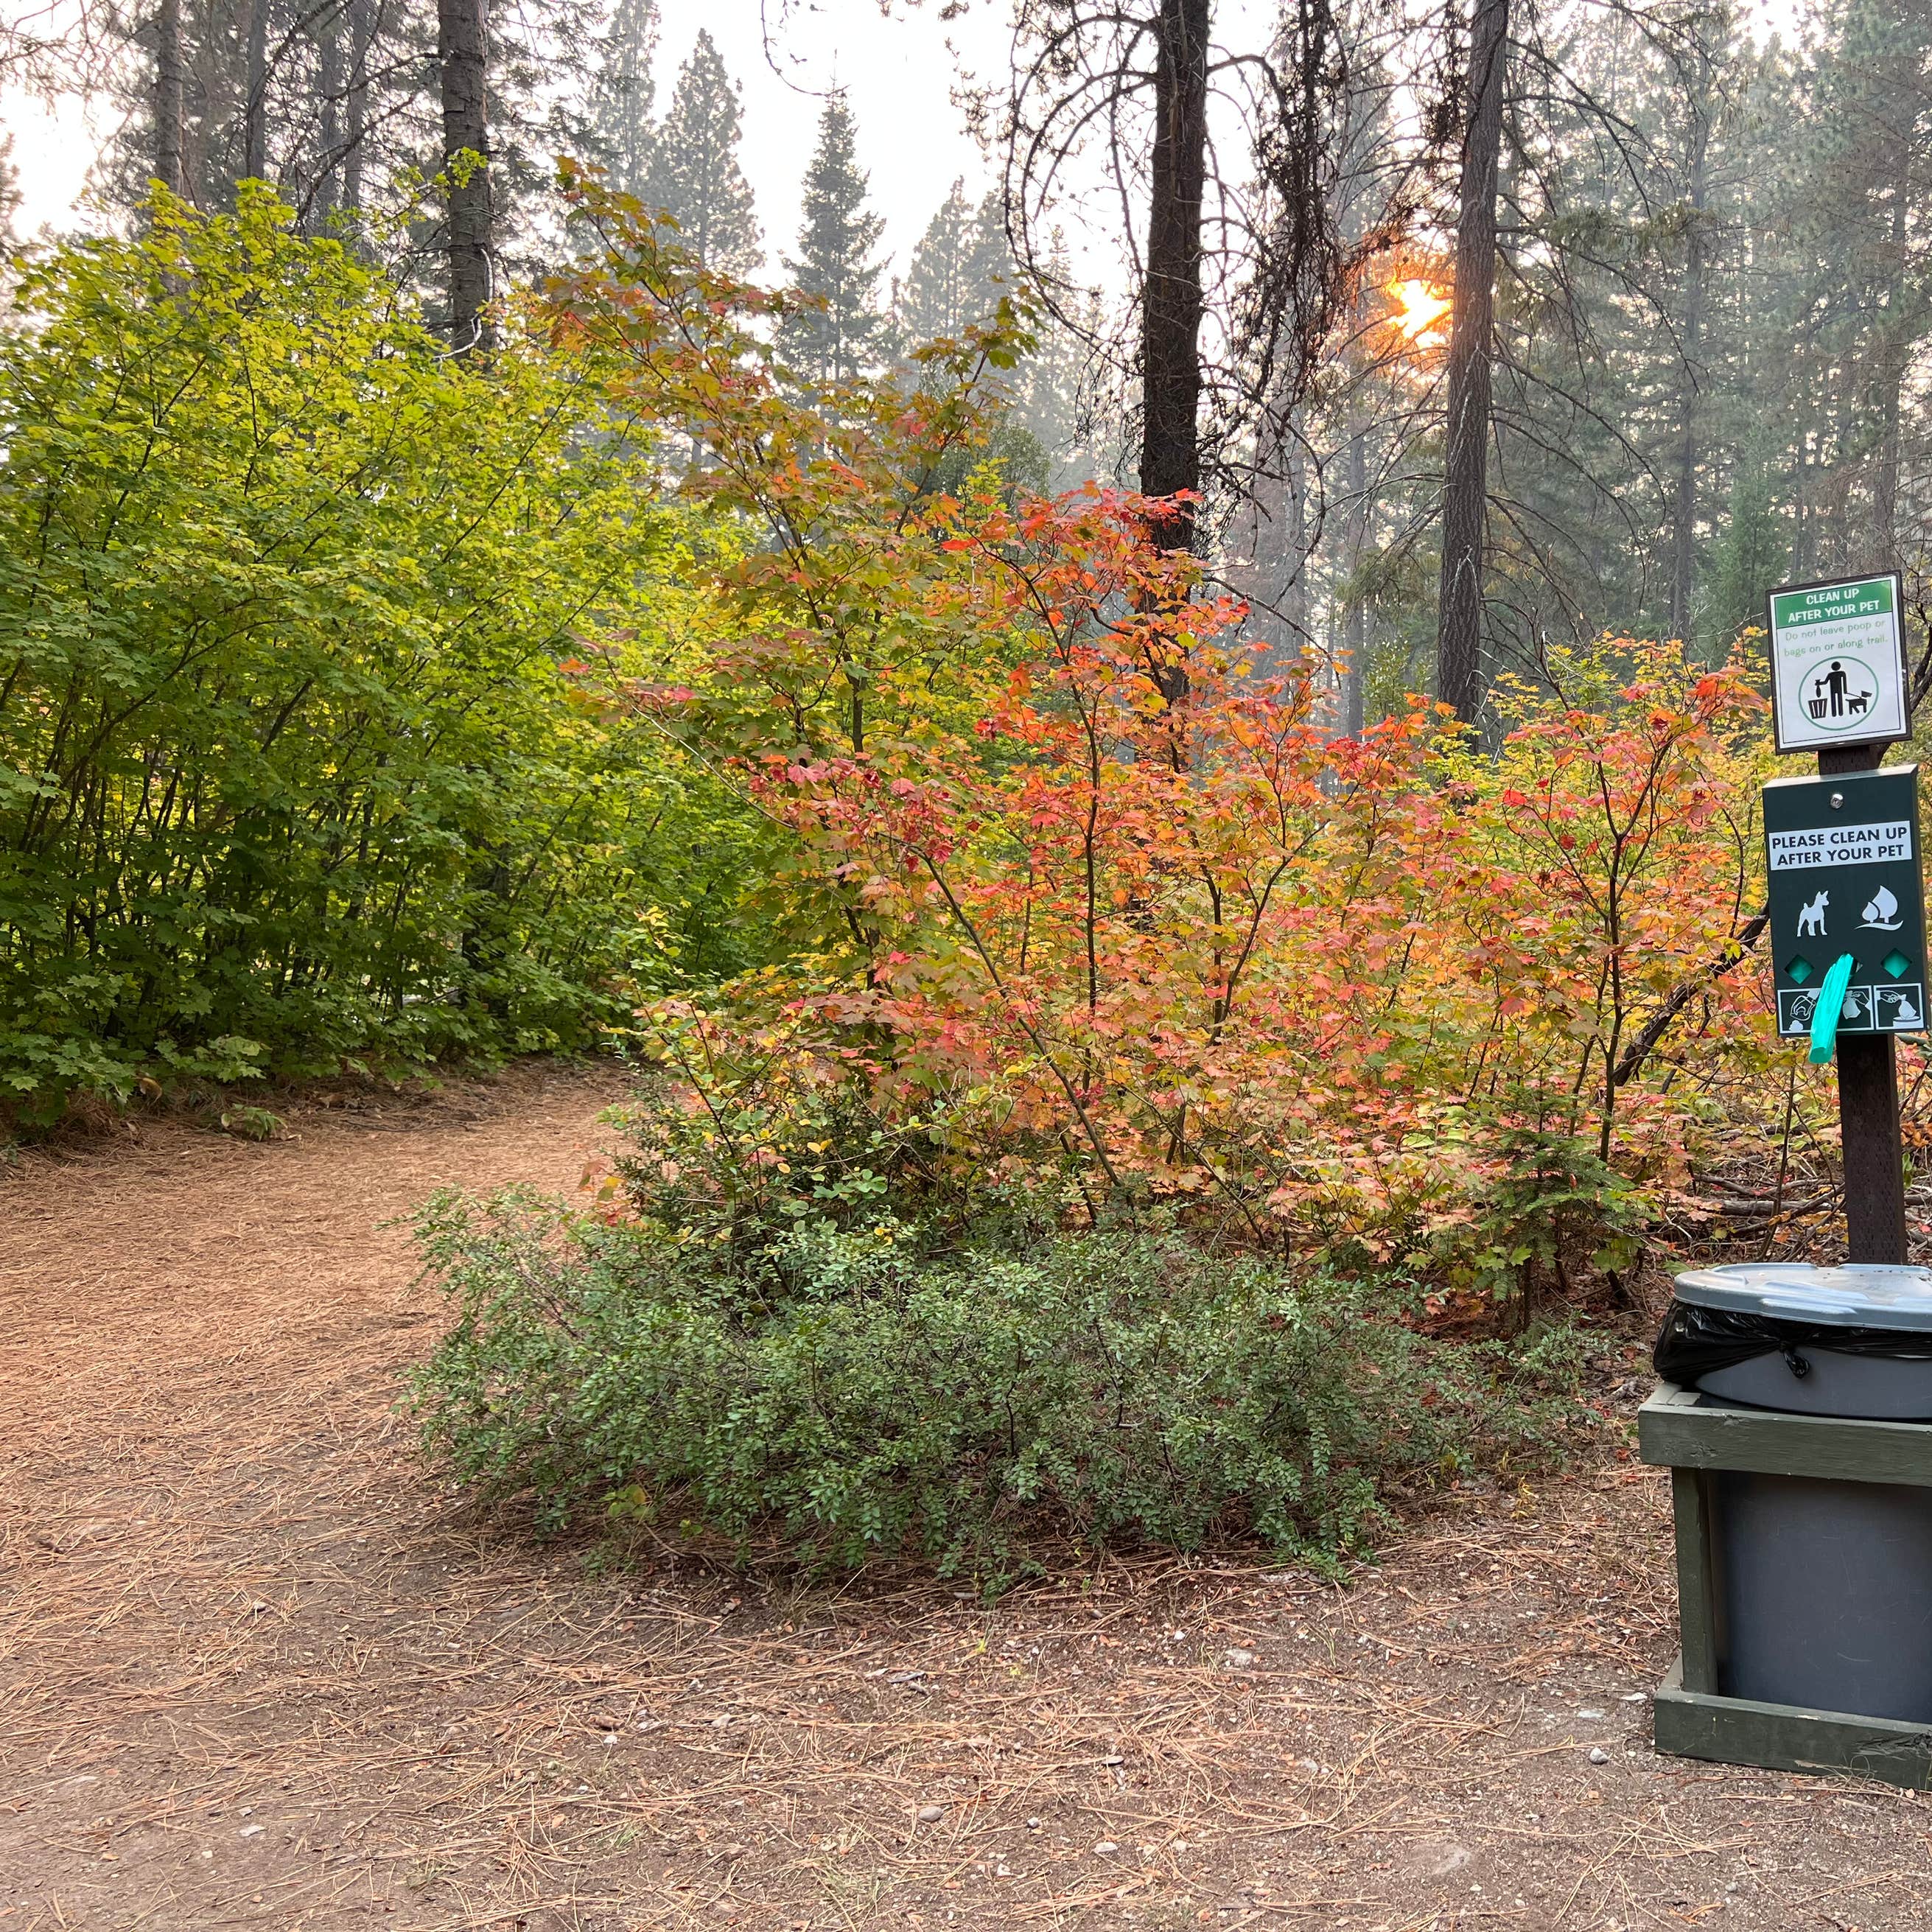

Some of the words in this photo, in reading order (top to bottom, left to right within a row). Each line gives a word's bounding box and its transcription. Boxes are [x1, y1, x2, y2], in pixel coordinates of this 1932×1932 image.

[1806, 591, 1840, 605] CLEAN
[1844, 588, 1859, 599] UP
[1788, 609, 1821, 623] AFTER
[1824, 604, 1856, 617] YOUR
[1860, 600, 1880, 612] PET
[1785, 631, 1798, 641] Do
[1802, 629, 1816, 639] not
[1820, 626, 1844, 635] leave
[1847, 622, 1872, 634] poop
[1784, 648, 1806, 657] bags
[1838, 637, 1863, 648] along
[1867, 635, 1888, 645] trail.
[1772, 834, 1824, 849] PLEASE
[1830, 829, 1880, 844] CLEAN
[1886, 827, 1907, 839] UP
[1777, 852, 1821, 866] AFTER
[1827, 847, 1872, 861] YOUR
[1878, 844, 1904, 858] PET
